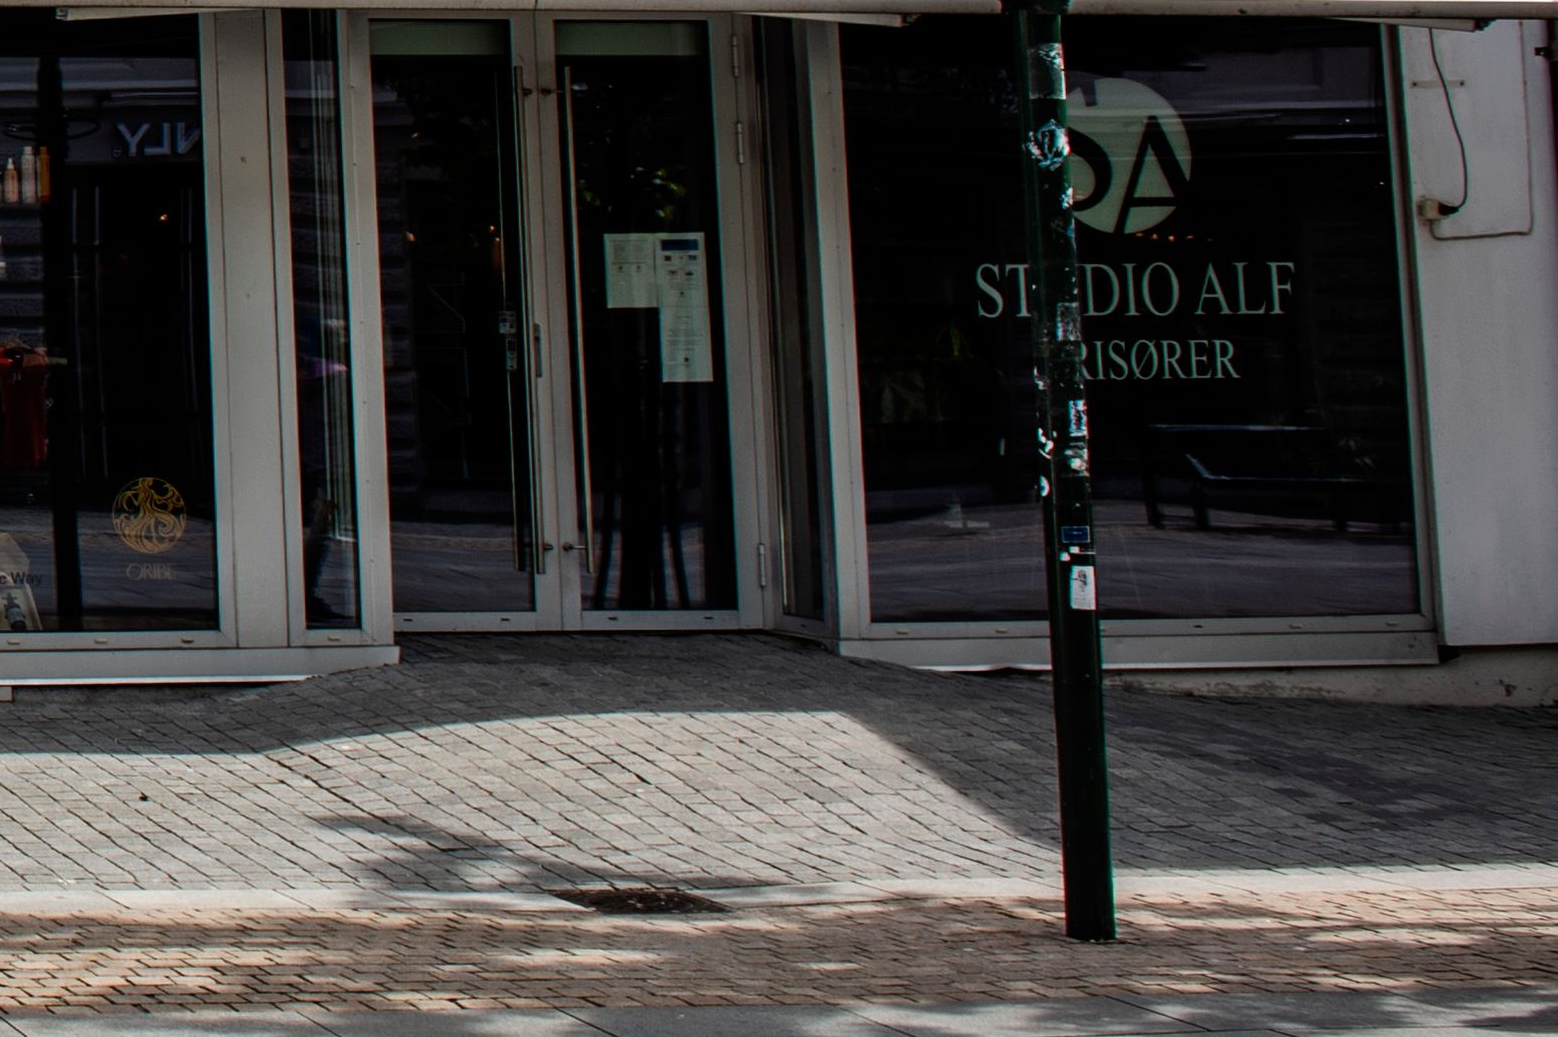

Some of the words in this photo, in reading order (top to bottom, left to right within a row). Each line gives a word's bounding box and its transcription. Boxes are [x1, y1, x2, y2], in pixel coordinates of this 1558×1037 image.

[974, 262, 1181, 318] STDIO
[1194, 262, 1296, 316] ALF
[1079, 339, 1241, 381] RISØRER
[10, 571, 42, 586] Way
